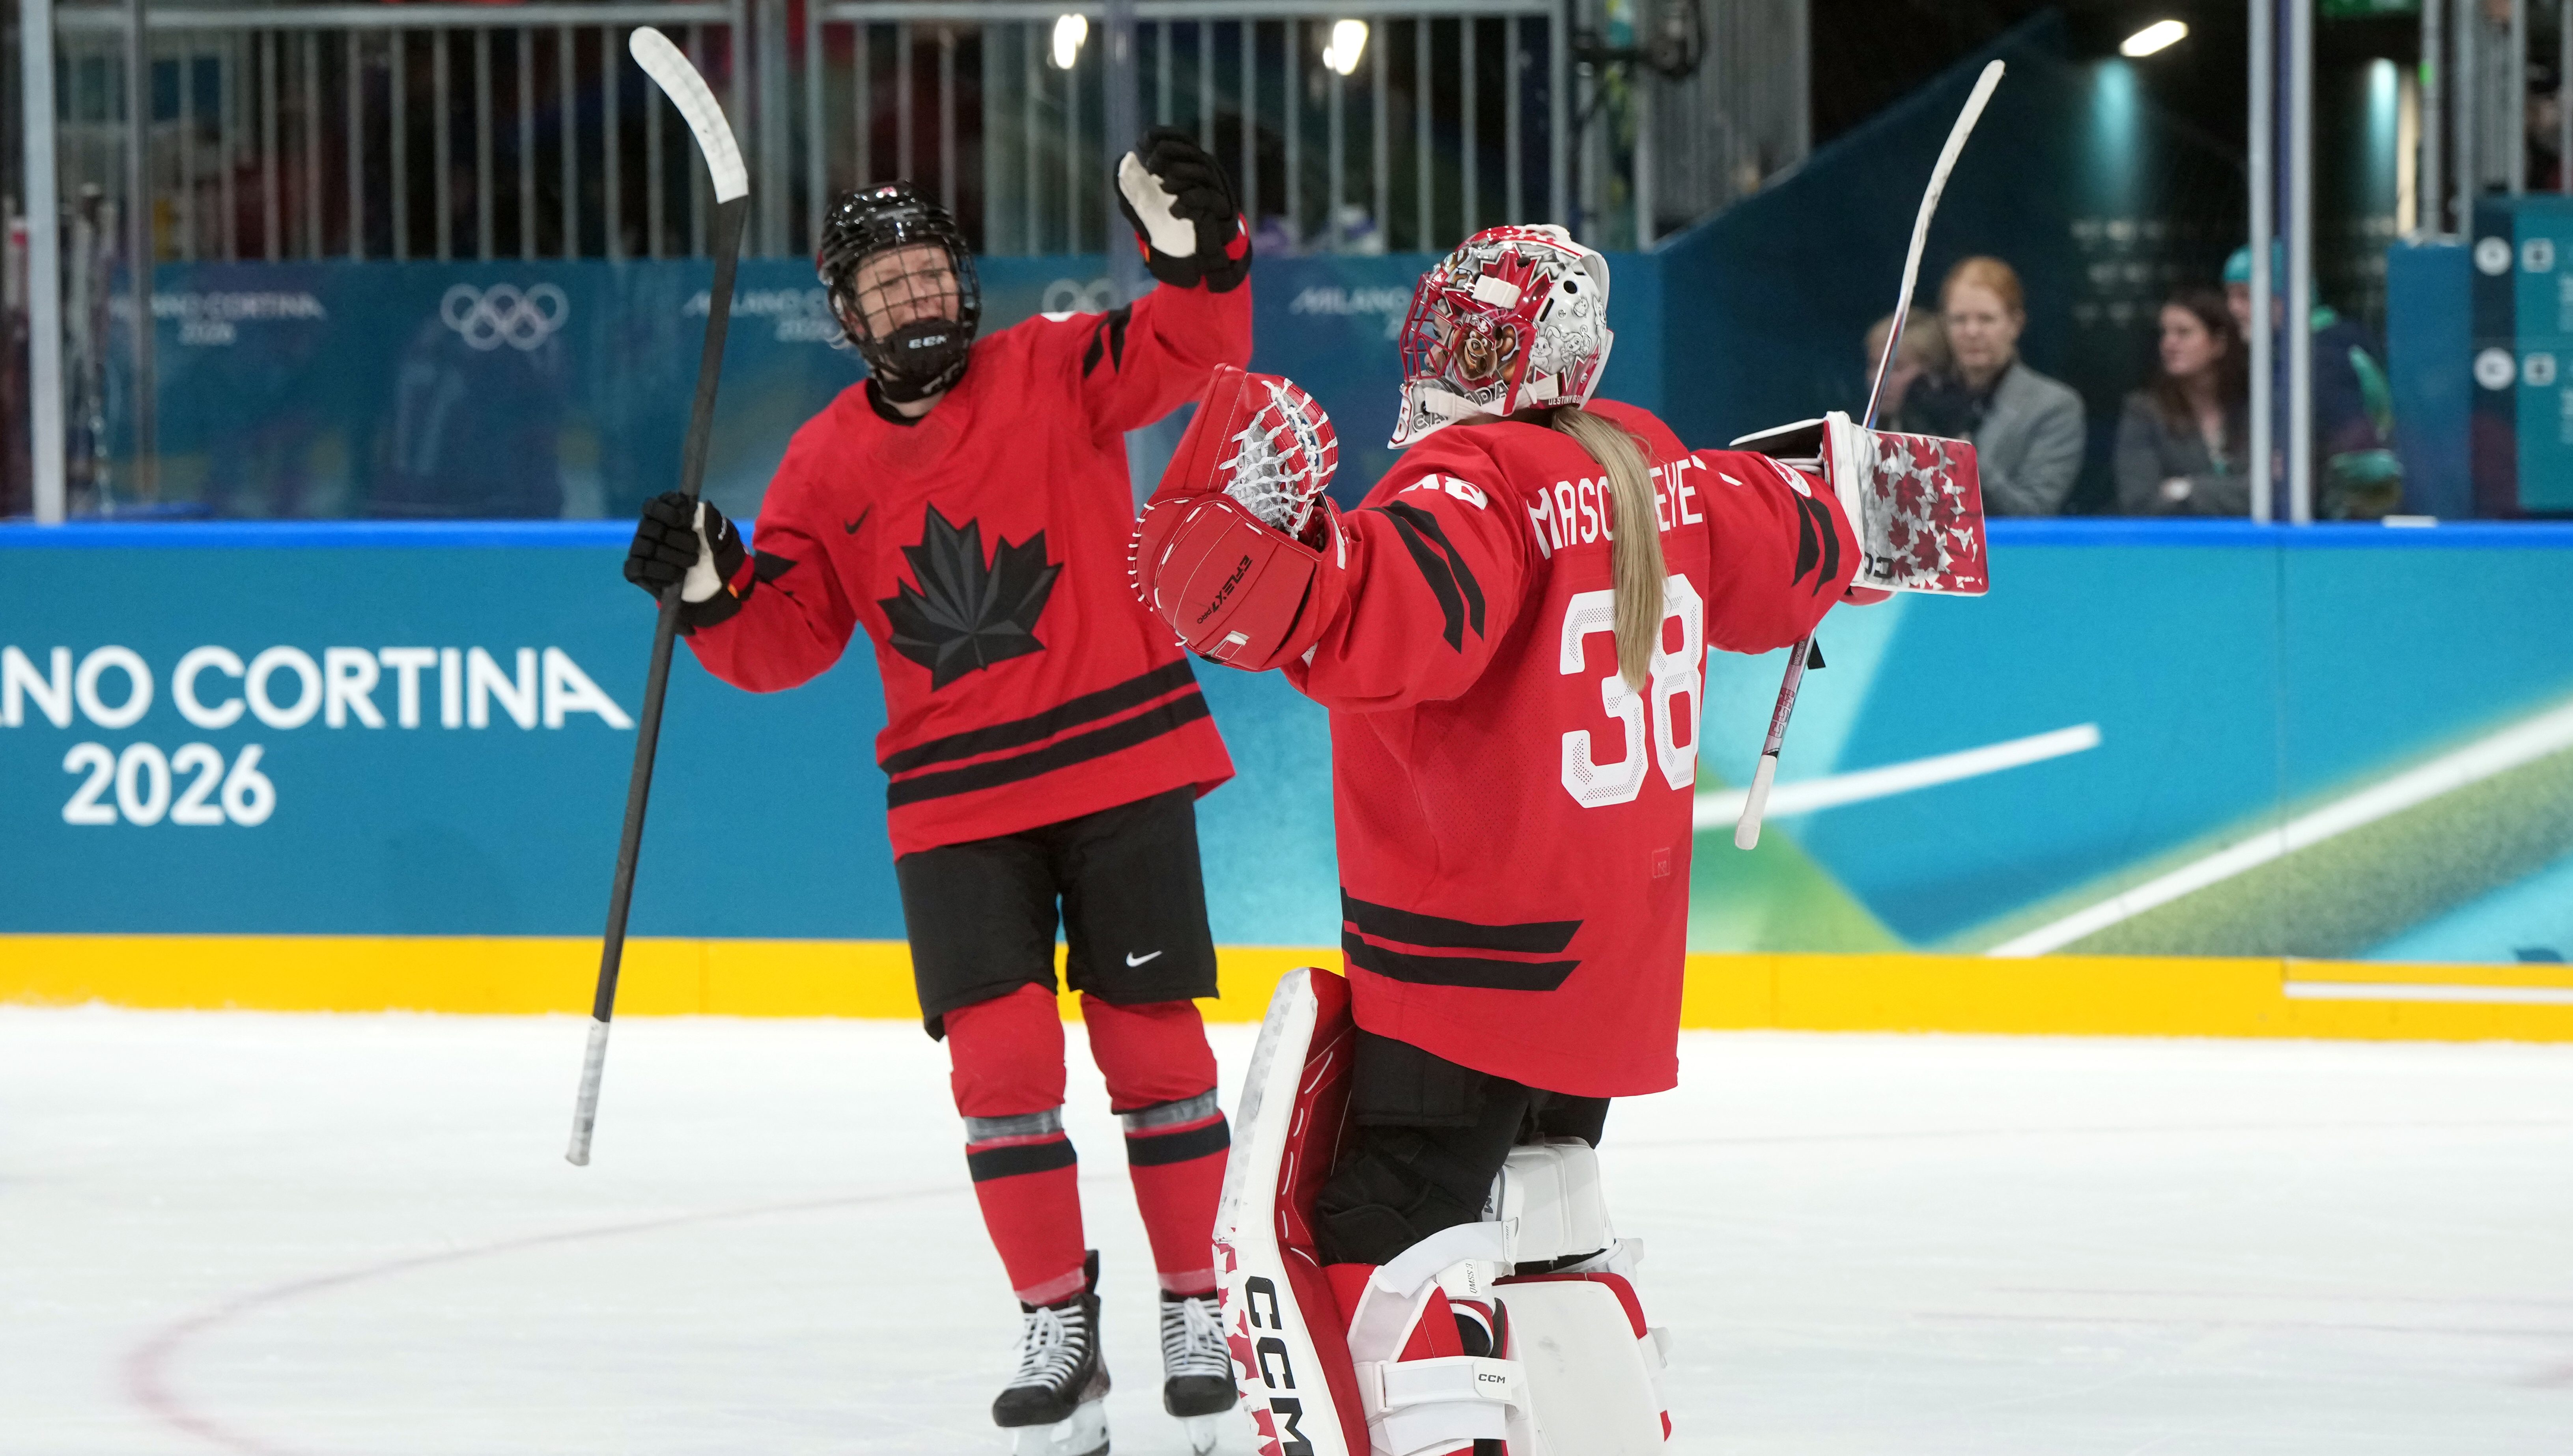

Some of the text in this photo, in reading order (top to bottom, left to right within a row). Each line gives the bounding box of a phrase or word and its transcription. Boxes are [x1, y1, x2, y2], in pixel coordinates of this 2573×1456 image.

[1526, 455, 1707, 560] MASCEYE
[0, 646, 633, 728] NO CORTINA
[1559, 573, 1703, 808] 38
[1768, 687, 1795, 739] CCM
[63, 743, 275, 825] 2026
[1245, 1276, 1315, 1456] CCM
[1478, 1374, 1505, 1384] CCM
